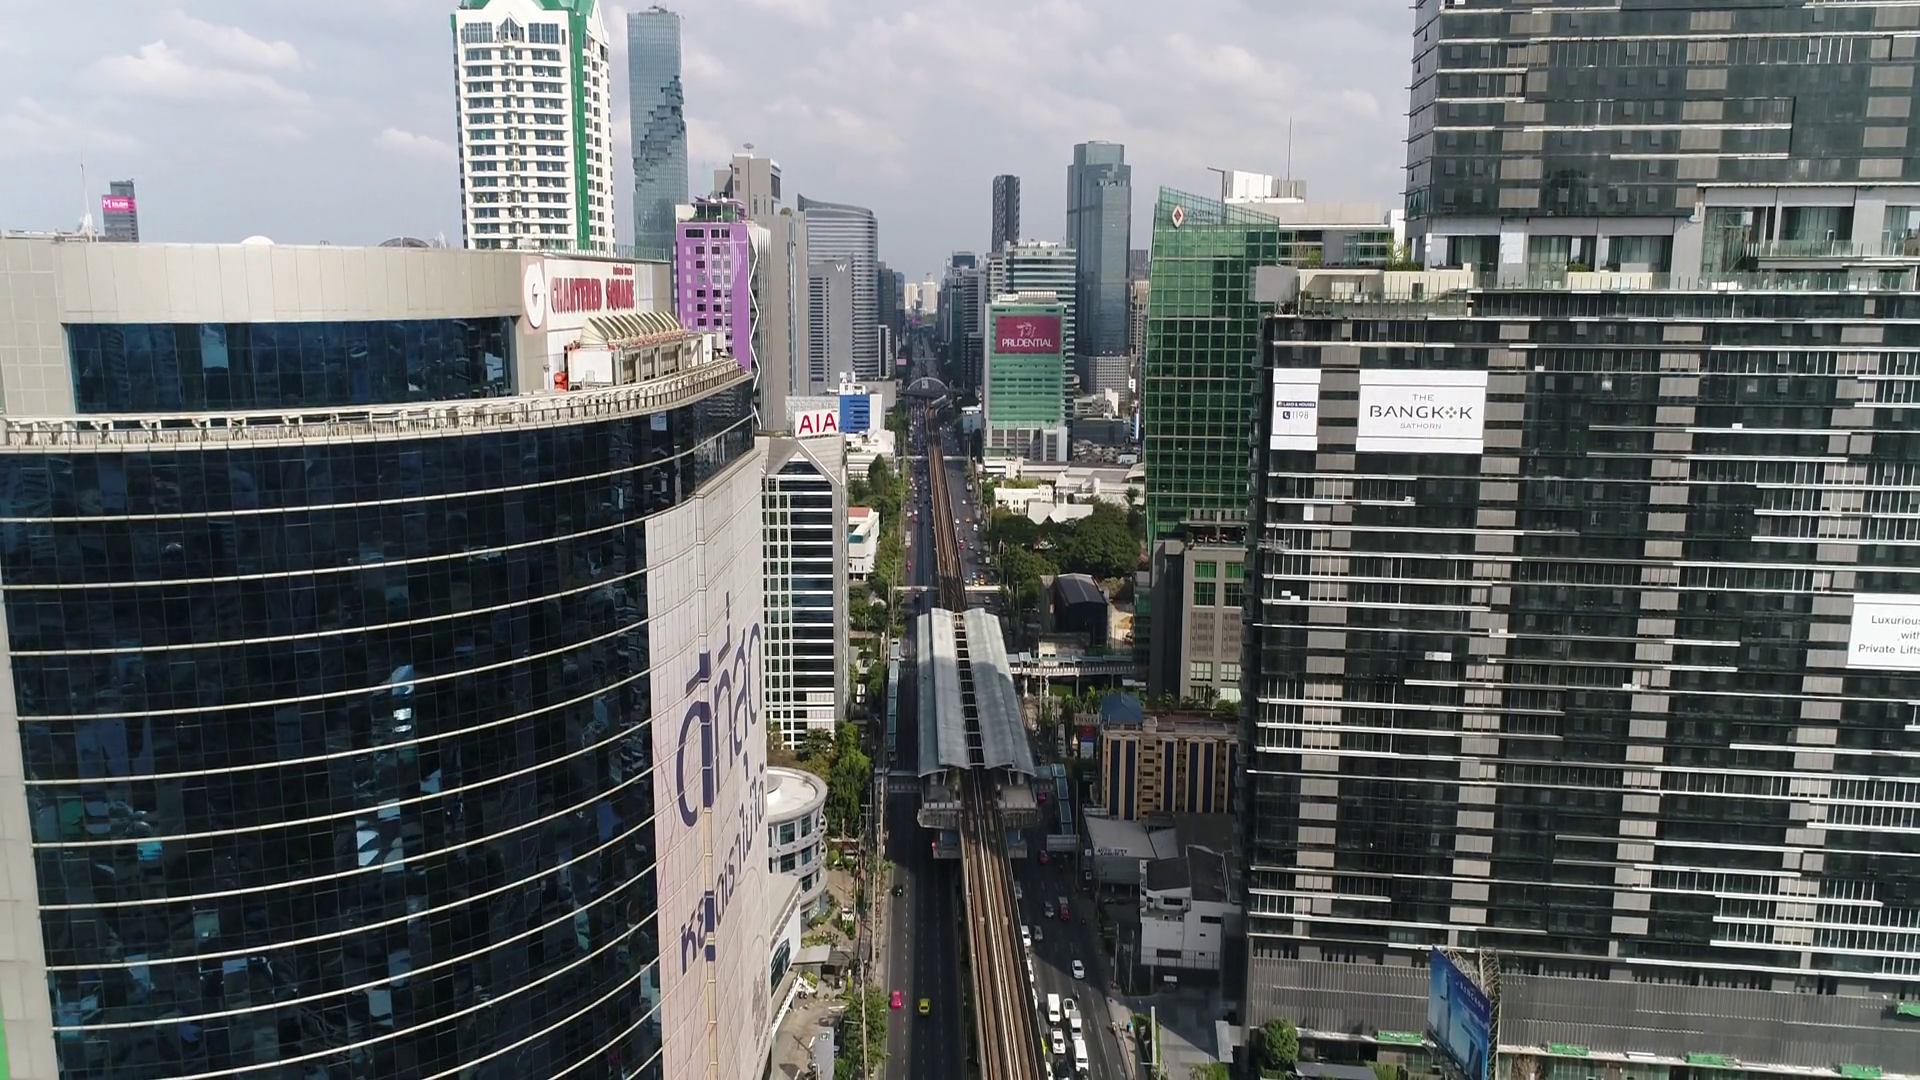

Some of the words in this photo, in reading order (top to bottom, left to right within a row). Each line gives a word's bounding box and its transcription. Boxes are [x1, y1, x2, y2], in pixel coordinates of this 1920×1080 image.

[835, 263, 847, 273] W
[550, 277, 603, 315] CHARTERED
[605, 278, 635, 311] SQUARE
[1001, 338, 1053, 347] PRUDENTIAL
[1412, 393, 1435, 402] THE
[1292, 411, 1309, 420] 1198
[798, 412, 838, 435] AIA
[1400, 422, 1442, 430] SATHORN
[1858, 643, 1896, 654] Private
